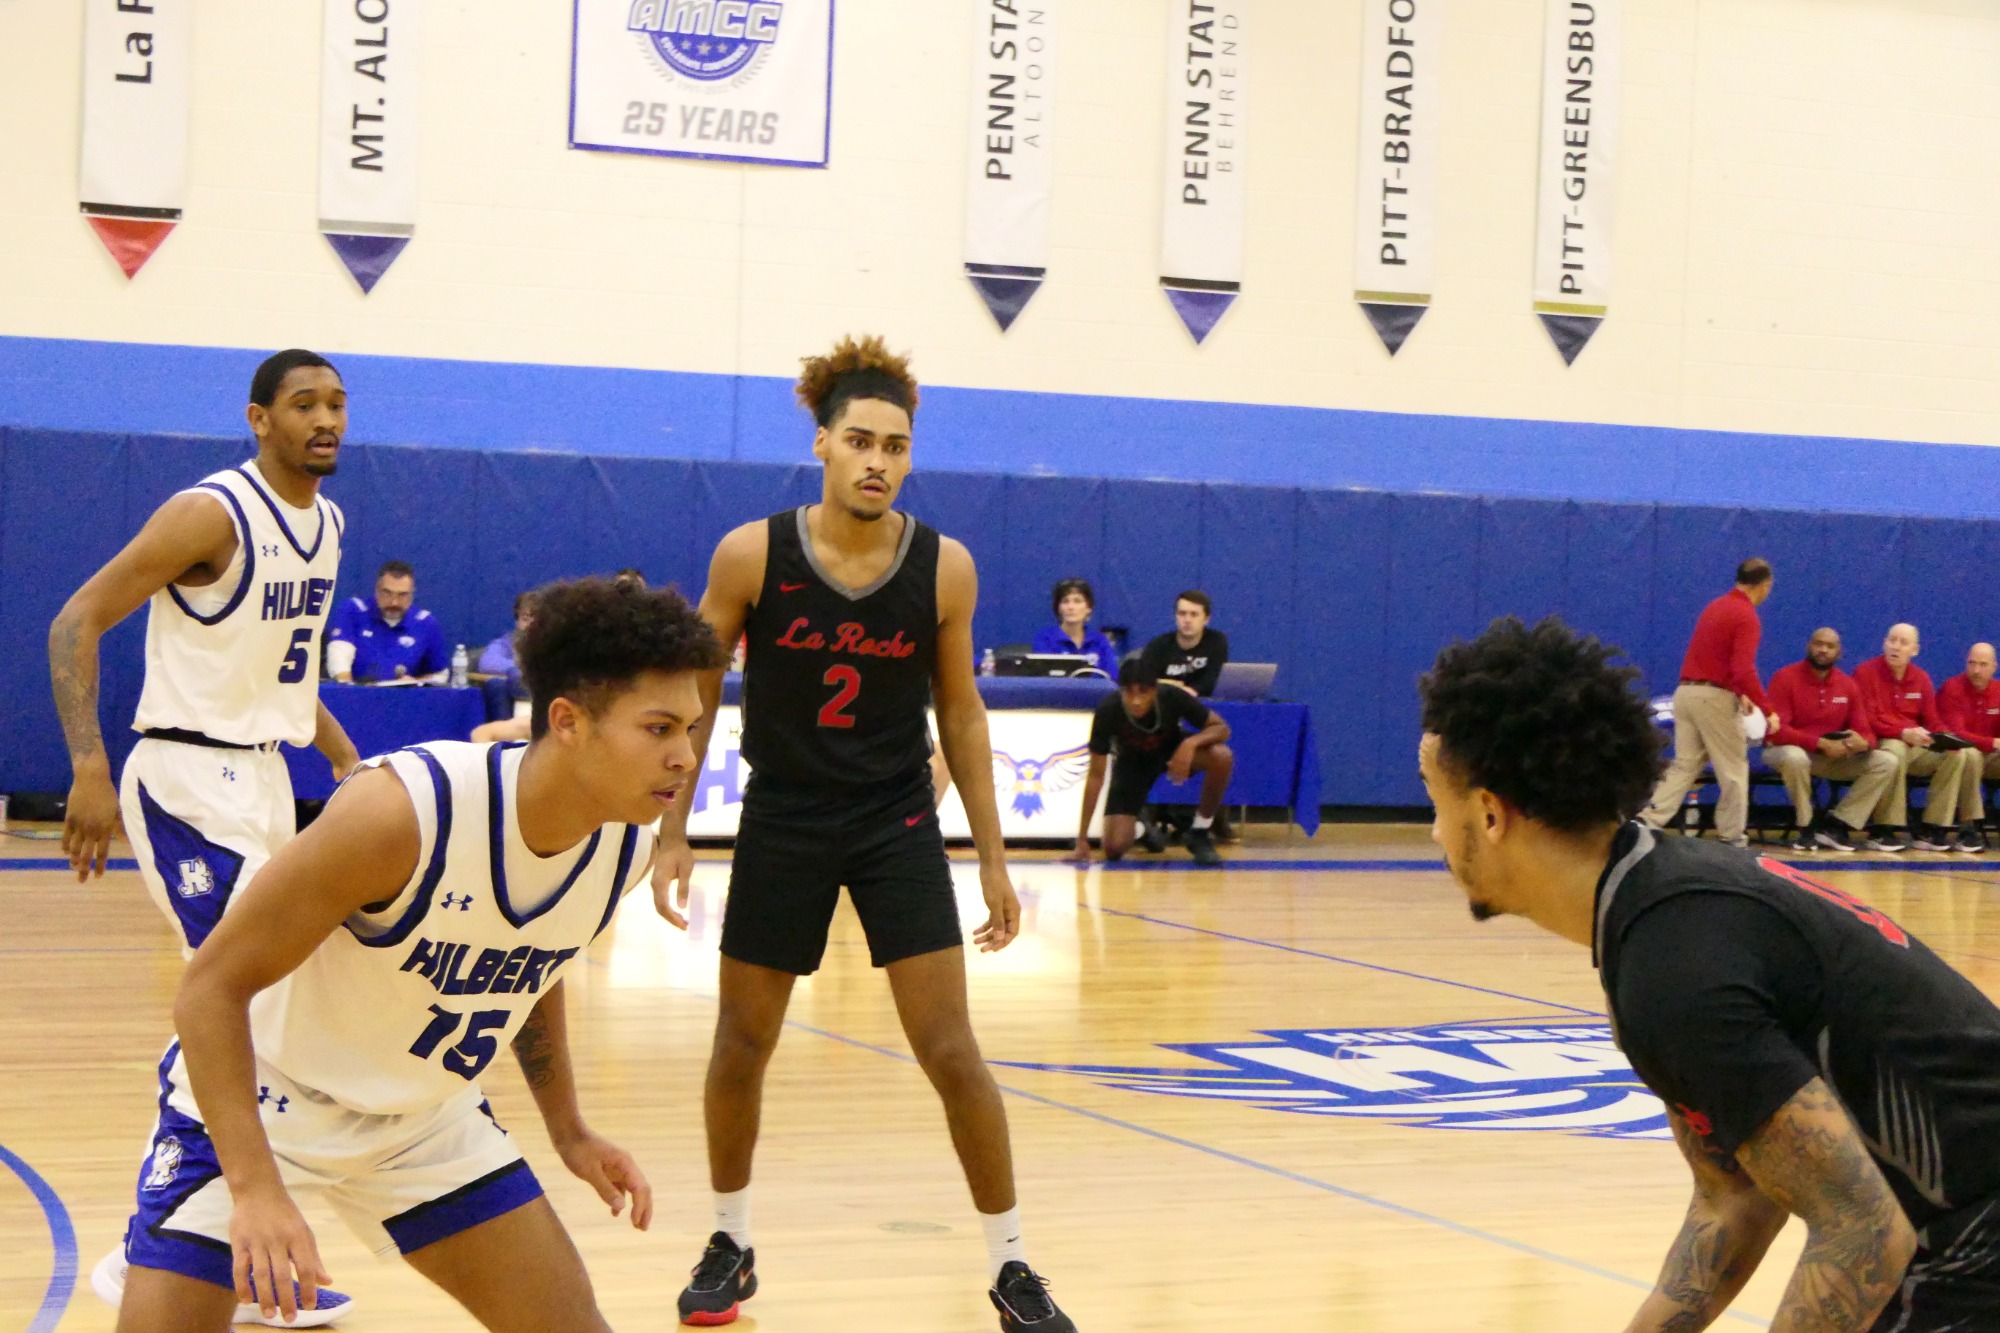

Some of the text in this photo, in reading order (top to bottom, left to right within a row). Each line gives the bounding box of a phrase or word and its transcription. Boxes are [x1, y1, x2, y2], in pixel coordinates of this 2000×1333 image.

[627, 0, 783, 43] AMCC
[115, 30, 153, 84] La
[351, 0, 389, 172] MT. ALO
[985, 0, 1018, 180] PENN STA
[1023, 9, 1045, 148] ALTOON
[622, 101, 779, 145] 25 YEARS
[1182, 0, 1215, 205] PENN STAT
[1215, 13, 1239, 173] BEHREND
[1380, 0, 1415, 266] PITT-BRADFO
[1559, 2, 1596, 294] PITT-GREENSBU
[278, 628, 313, 683] 5
[776, 617, 917, 658] La Roche
[817, 663, 862, 729] 2
[399, 936, 581, 995] HILBERT
[1303, 1026, 1612, 1044] HILBER
